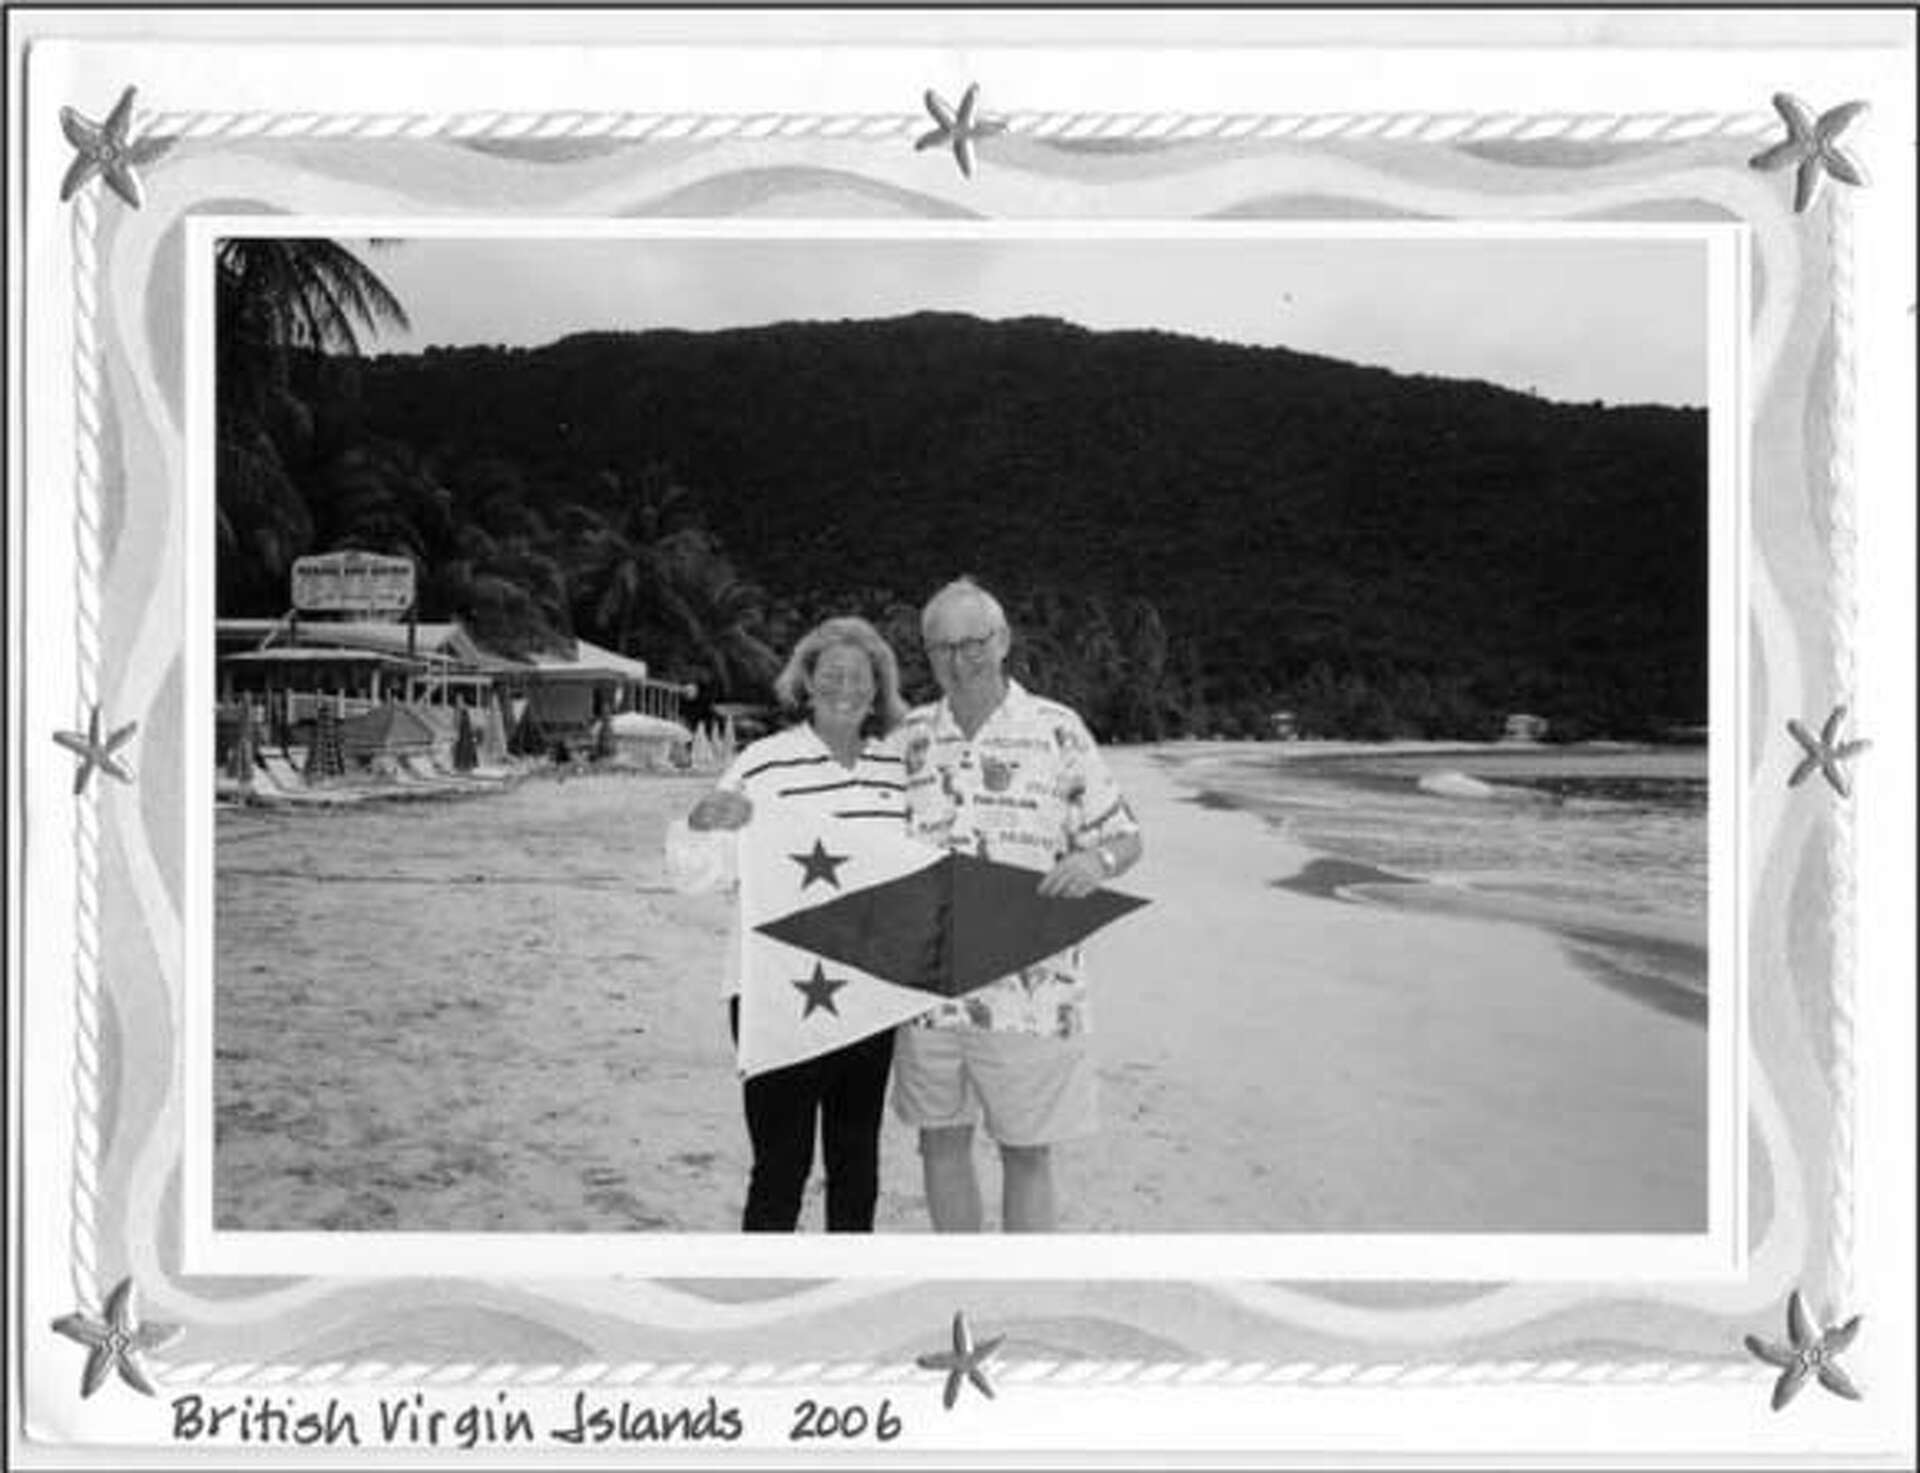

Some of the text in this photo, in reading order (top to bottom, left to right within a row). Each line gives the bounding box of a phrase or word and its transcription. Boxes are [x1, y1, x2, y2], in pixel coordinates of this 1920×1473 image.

[172, 1393, 902, 1449] British Virgin Islands 2006
